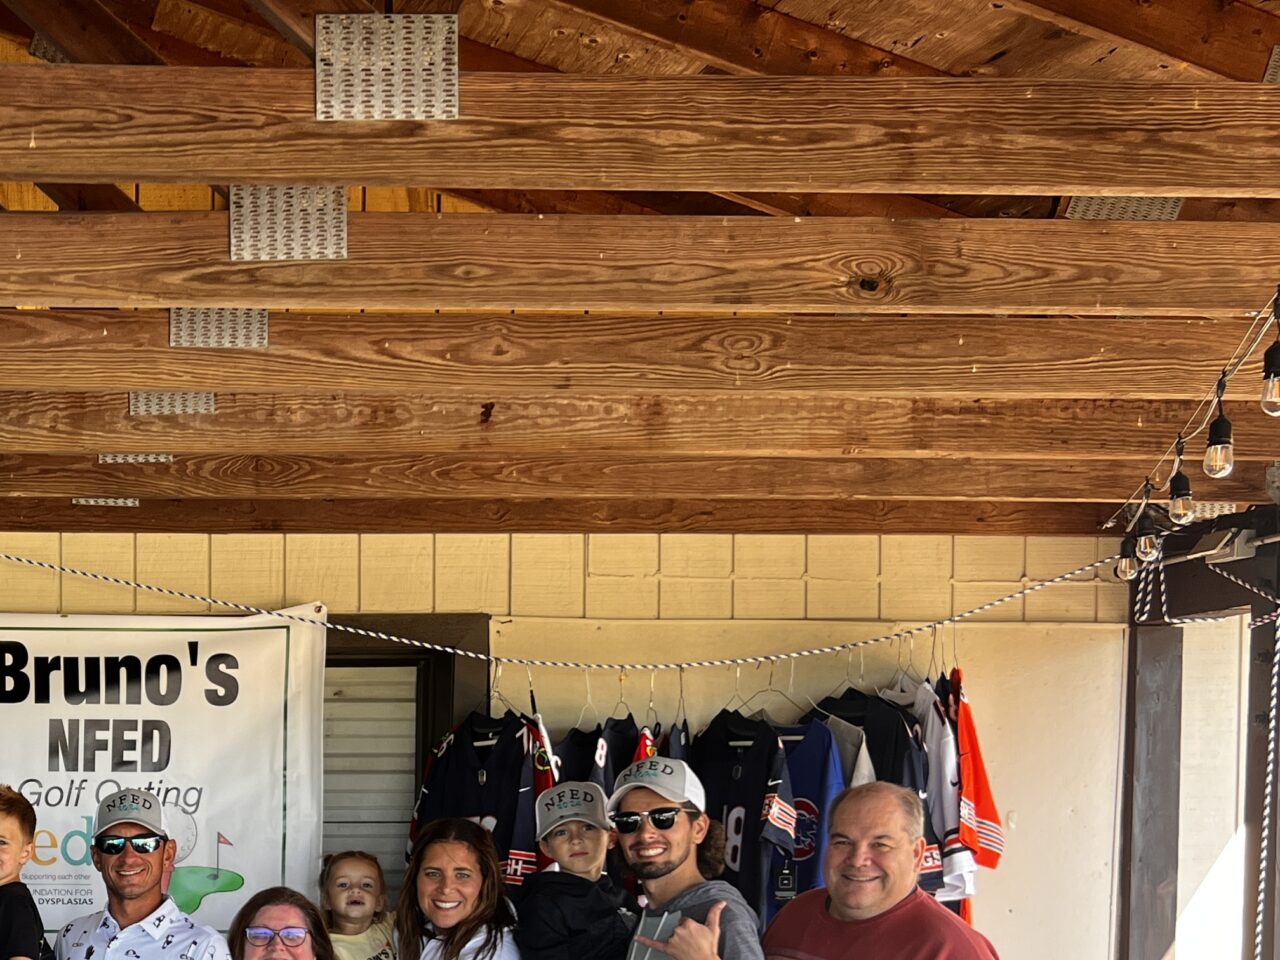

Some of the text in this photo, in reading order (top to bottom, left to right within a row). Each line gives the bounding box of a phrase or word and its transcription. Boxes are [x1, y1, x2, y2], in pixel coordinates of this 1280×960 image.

[48, 718, 172, 773] NFED
[623, 761, 674, 781] NFED
[17, 778, 204, 814] Golf Oting
[106, 794, 152, 812] NFED
[544, 789, 594, 811] NFED
[21, 874, 56, 882] Supporting
